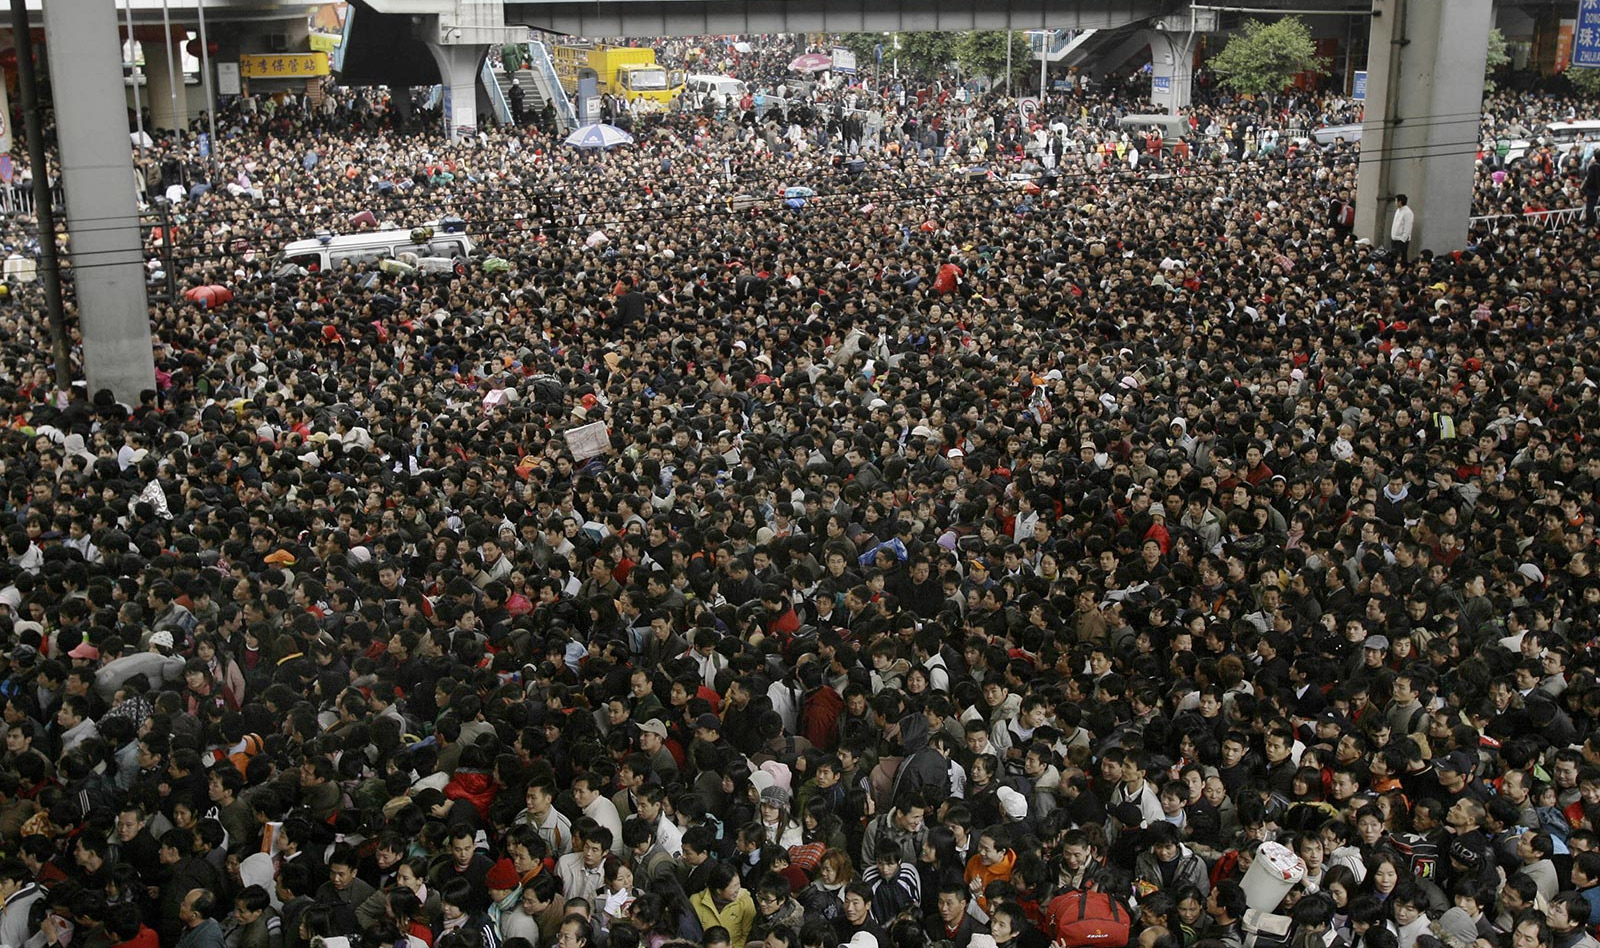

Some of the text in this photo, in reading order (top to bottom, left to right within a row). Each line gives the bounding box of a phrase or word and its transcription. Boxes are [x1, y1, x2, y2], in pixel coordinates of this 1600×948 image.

[240, 58, 316, 74] 行李保管站
